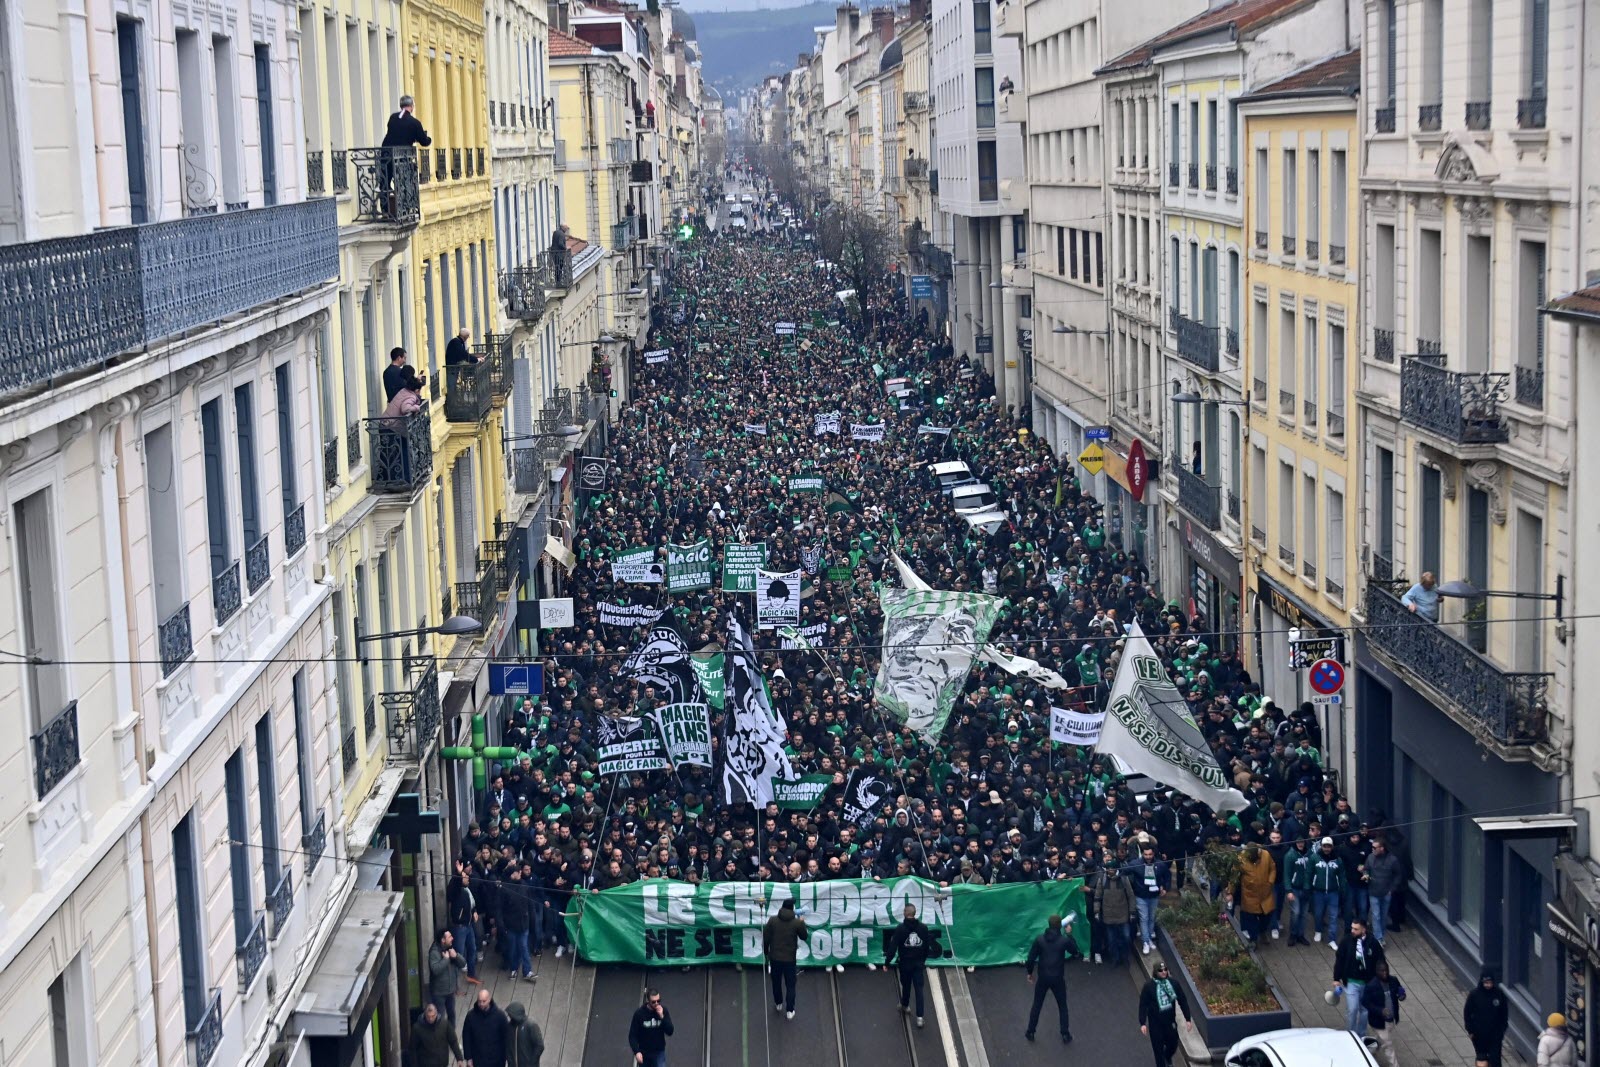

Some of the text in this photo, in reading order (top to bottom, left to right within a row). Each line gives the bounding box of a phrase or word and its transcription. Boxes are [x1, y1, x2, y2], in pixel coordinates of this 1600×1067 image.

[623, 550, 654, 562] CHAUDRON
[669, 547, 709, 565] MAGIC
[668, 561, 709, 576] SPIRIT
[759, 571, 798, 581] WED
[669, 577, 711, 589] DISSOLVED
[596, 601, 643, 615] #TOUCHEPAS
[600, 610, 639, 627] ÀMESKOPS
[776, 622, 827, 638] #CHEPAS
[780, 635, 823, 650] ÀMOPS
[1317, 641, 1332, 650] Chic
[1136, 658, 1160, 680] LE
[660, 704, 706, 726] MAGIC
[1055, 715, 1065, 724] LE
[663, 721, 708, 748] FANS
[1112, 698, 1224, 787] NE SE DISSOUT
[598, 736, 660, 759] LIBERTÉ
[625, 751, 643, 759] POUR
[601, 757, 663, 773] MAGIC FANS
[642, 878, 954, 926] LE CHAUDRON
[645, 928, 685, 960] NE
[694, 927, 734, 958] SE
[742, 927, 873, 960] DOUT
